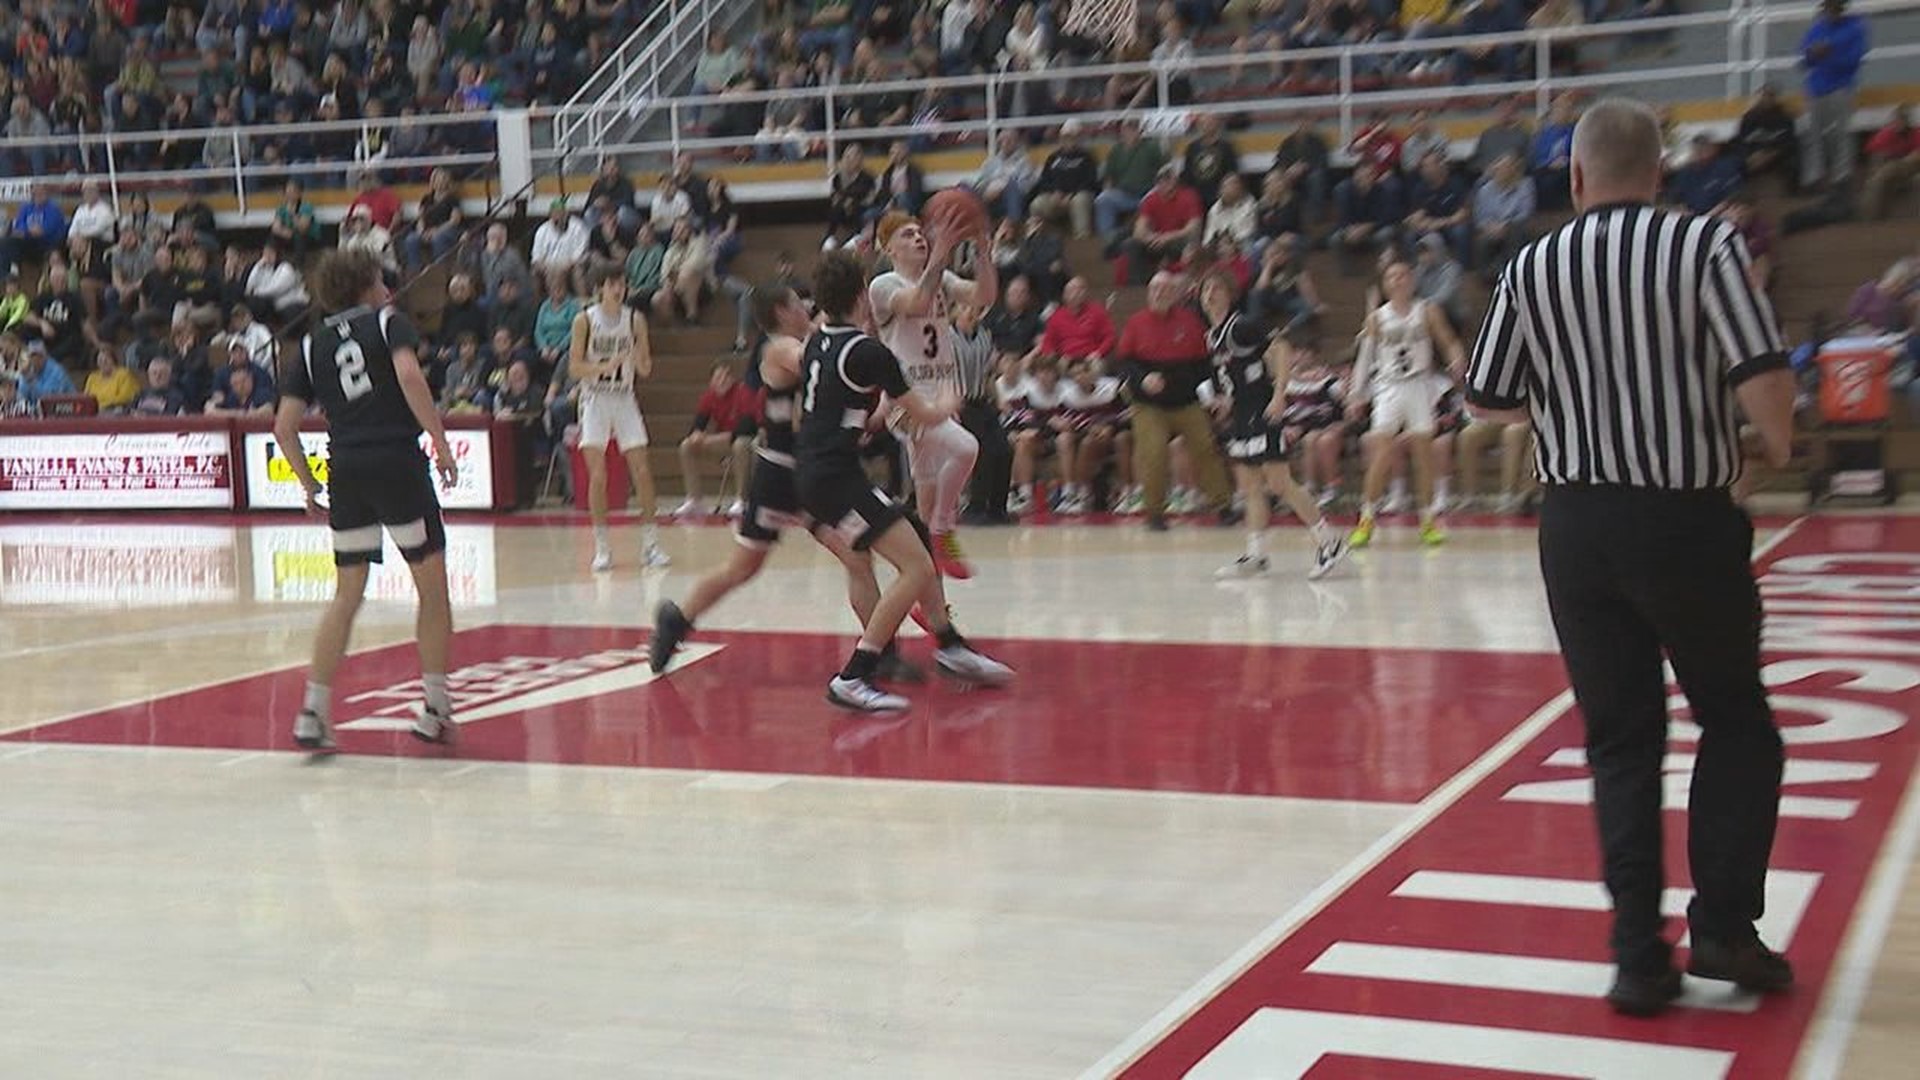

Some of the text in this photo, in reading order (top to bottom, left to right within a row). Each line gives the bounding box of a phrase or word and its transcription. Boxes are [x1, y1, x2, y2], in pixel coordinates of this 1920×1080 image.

[923, 324, 938, 359] 3
[334, 338, 373, 401] 2
[803, 359, 821, 412] 1
[77, 456, 122, 476] EVANS
